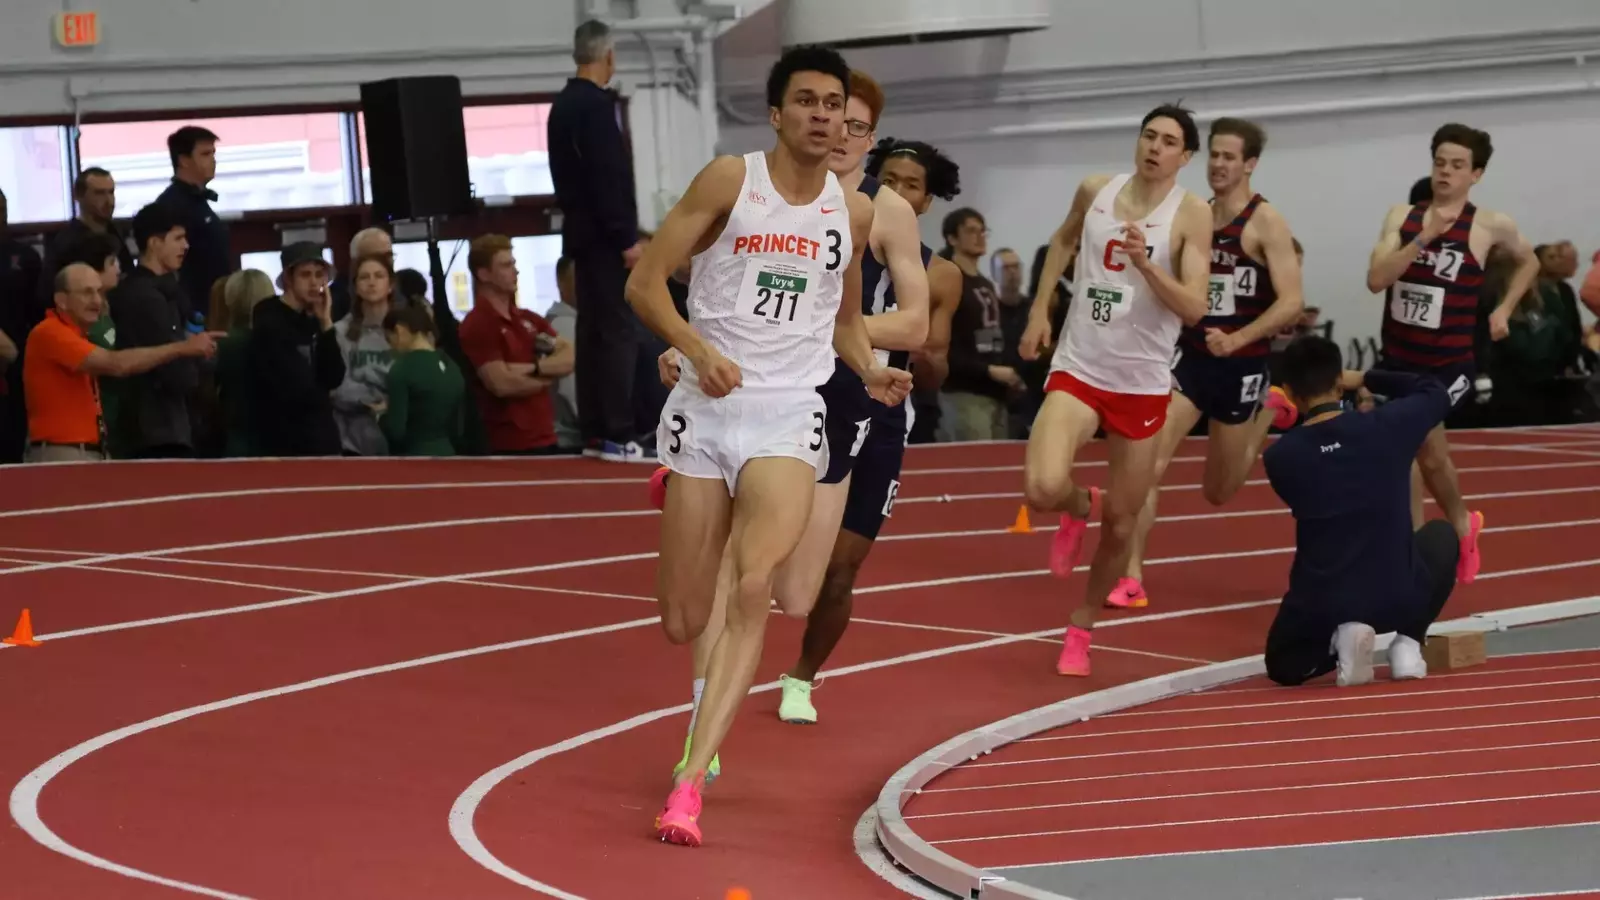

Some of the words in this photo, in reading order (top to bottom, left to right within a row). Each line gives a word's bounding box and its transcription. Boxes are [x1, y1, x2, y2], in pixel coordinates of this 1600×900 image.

[63, 13, 96, 45] EXIT
[825, 229, 842, 271] 3
[1103, 238, 1128, 272] C
[1439, 251, 1457, 278] 2
[770, 275, 788, 289] Ivy
[1238, 268, 1253, 294] 4
[752, 287, 799, 321] 211
[1092, 300, 1111, 323] 83
[1402, 300, 1429, 322] 172
[1245, 376, 1259, 399] 4
[669, 414, 687, 454] 3
[809, 411, 824, 452] 3
